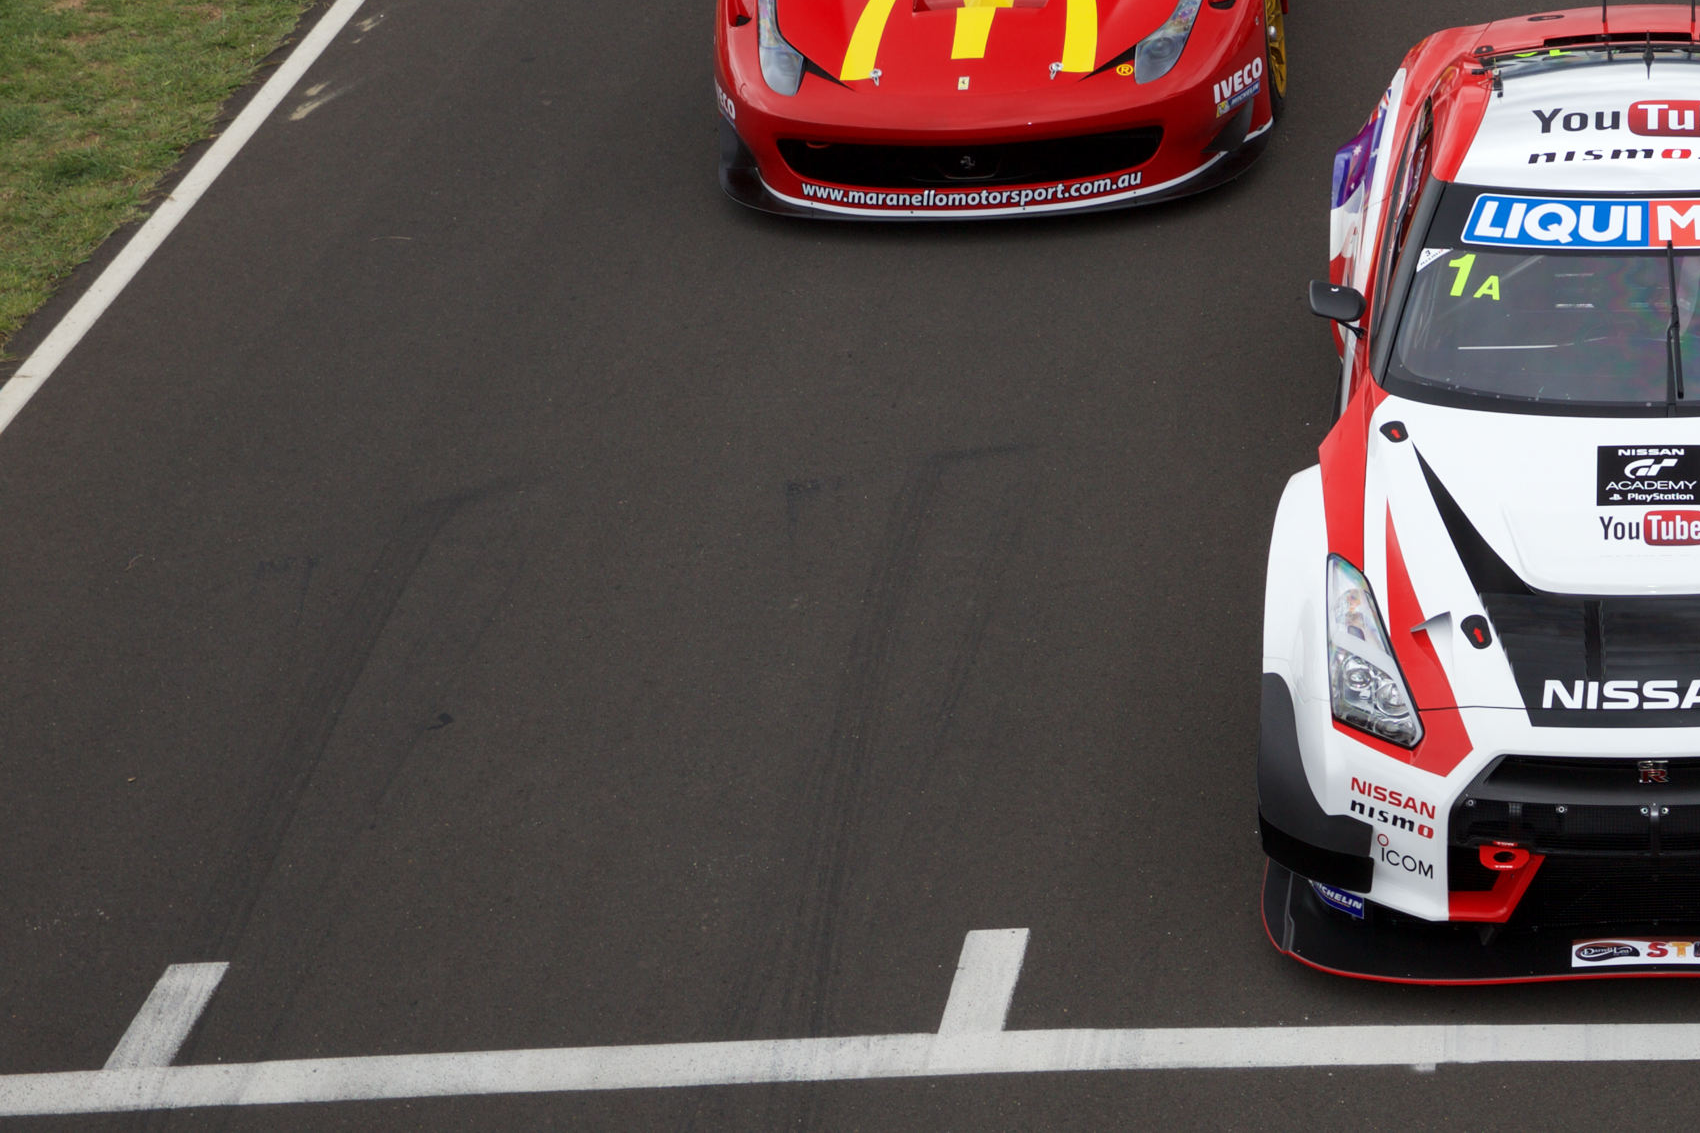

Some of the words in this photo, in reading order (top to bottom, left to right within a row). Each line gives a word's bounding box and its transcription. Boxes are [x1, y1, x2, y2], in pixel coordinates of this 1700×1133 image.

[1213, 56, 1263, 104] IVECO
[801, 171, 1143, 208] www.maranellomotorsport.com.au
[1473, 199, 1644, 242] LIQUI
[1617, 447, 1685, 456] NISSAN
[1605, 480, 1697, 491] ACADEMY
[1627, 492, 1695, 502] PlayStation
[1351, 776, 1436, 820] NISSAN
